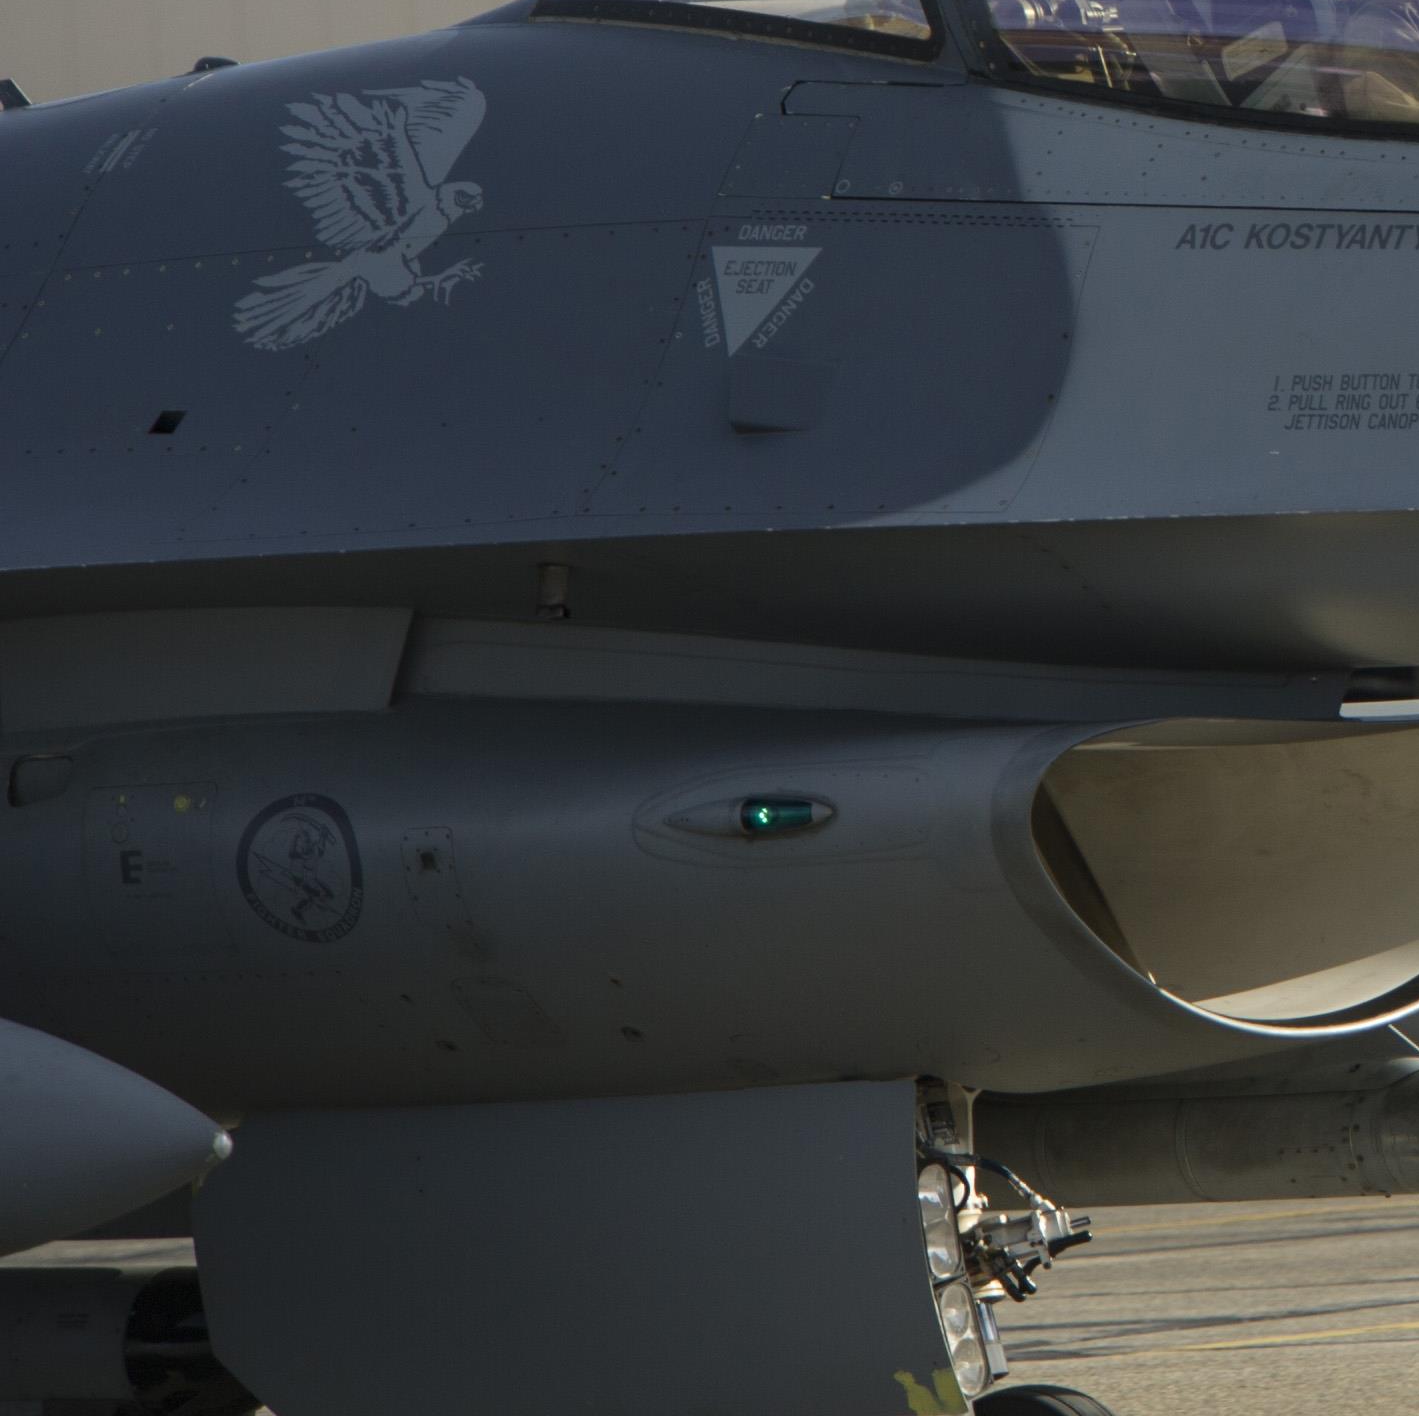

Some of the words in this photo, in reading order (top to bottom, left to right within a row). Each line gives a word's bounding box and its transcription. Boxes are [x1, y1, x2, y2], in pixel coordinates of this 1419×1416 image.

[737, 224, 808, 241] DANGER
[1174, 222, 1234, 250] A1C
[723, 260, 799, 276] EJECTION
[736, 278, 775, 294] SEAT
[697, 277, 721, 349] DANGER
[750, 277, 816, 349] DANGER
[1273, 375, 1286, 392] 1.
[1291, 374, 1334, 392] PUSH
[1340, 373, 1401, 391] BUTTON
[1267, 394, 1282, 412] 2.
[1288, 394, 1329, 411] PULL
[1335, 394, 1372, 411] RING
[1378, 393, 1409, 411] OUT
[1284, 413, 1361, 430] JETTISON
[120, 850, 143, 885] E
